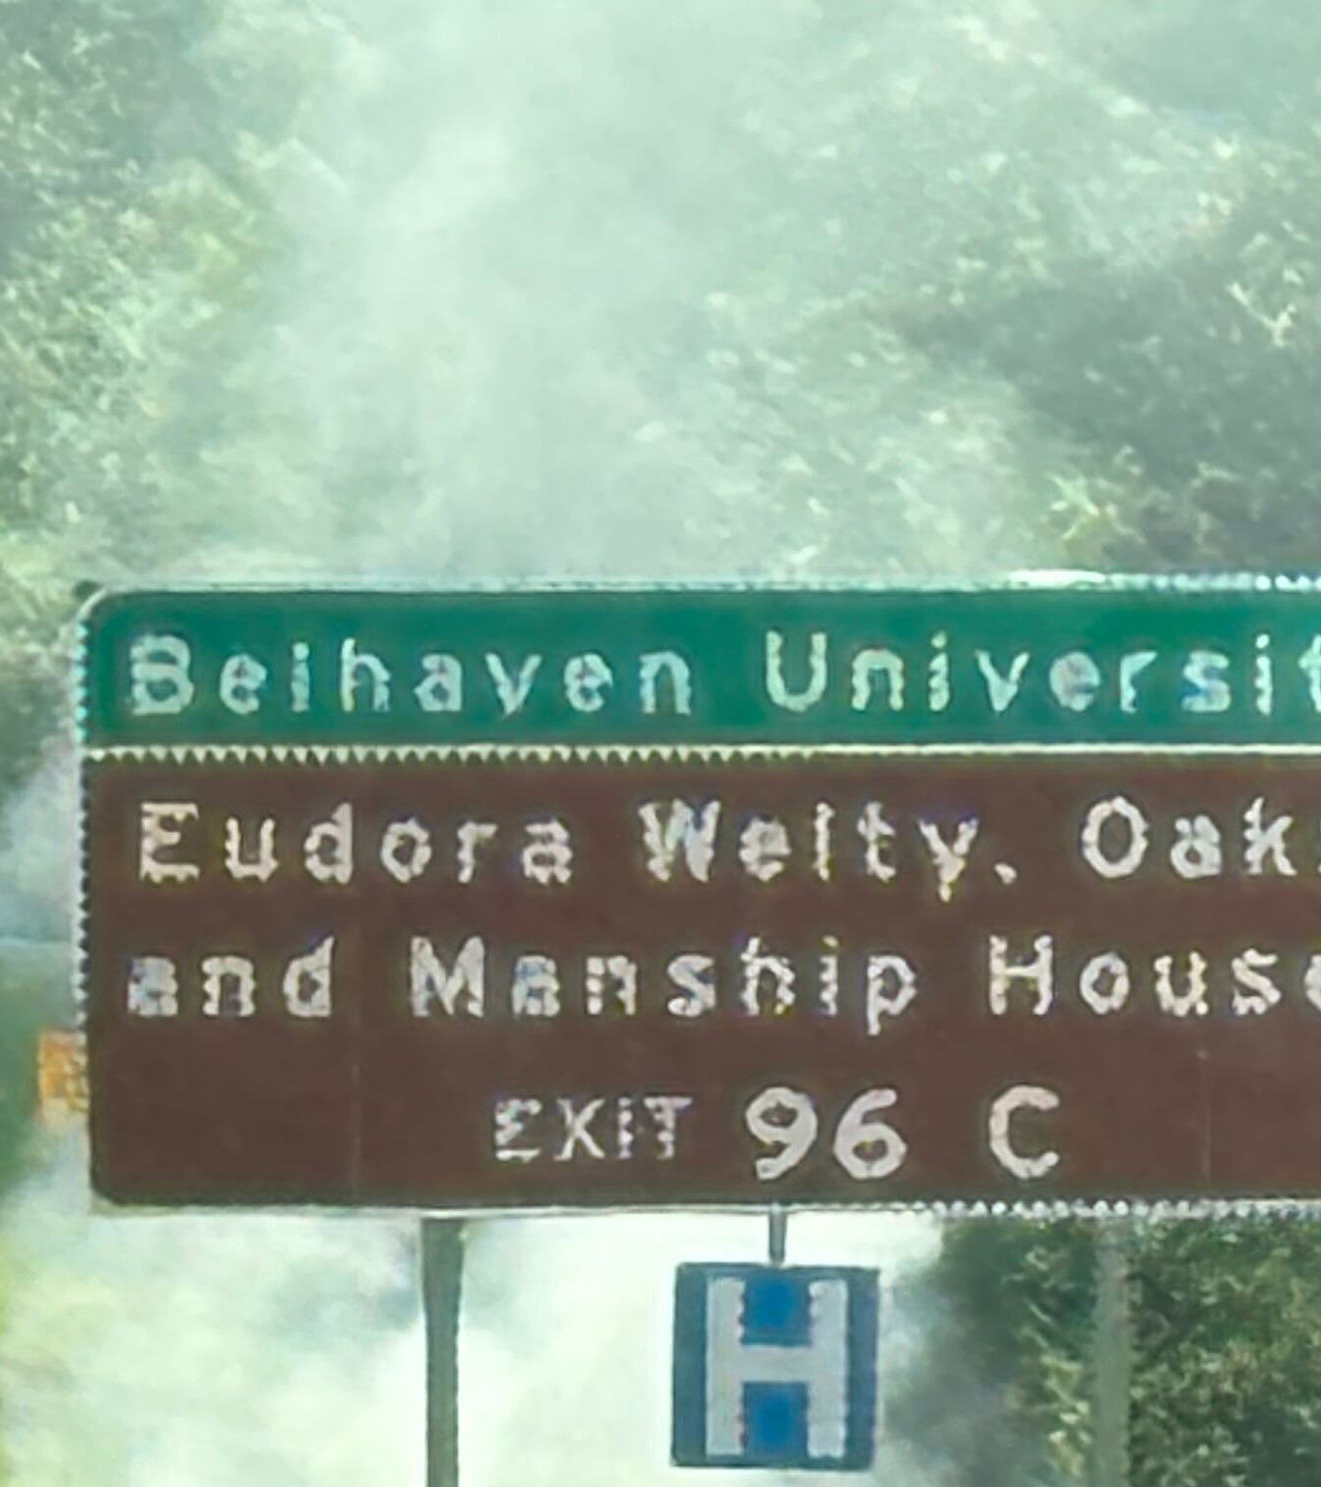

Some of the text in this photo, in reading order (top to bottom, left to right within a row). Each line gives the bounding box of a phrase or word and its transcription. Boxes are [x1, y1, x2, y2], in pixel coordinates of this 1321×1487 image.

[138, 801, 574, 886] Eudora
[126, 935, 336, 1018] and
[408, 934, 919, 1036] Manship
[493, 1085, 1061, 1181] EXIT 96 C
[705, 1276, 850, 1459] H
